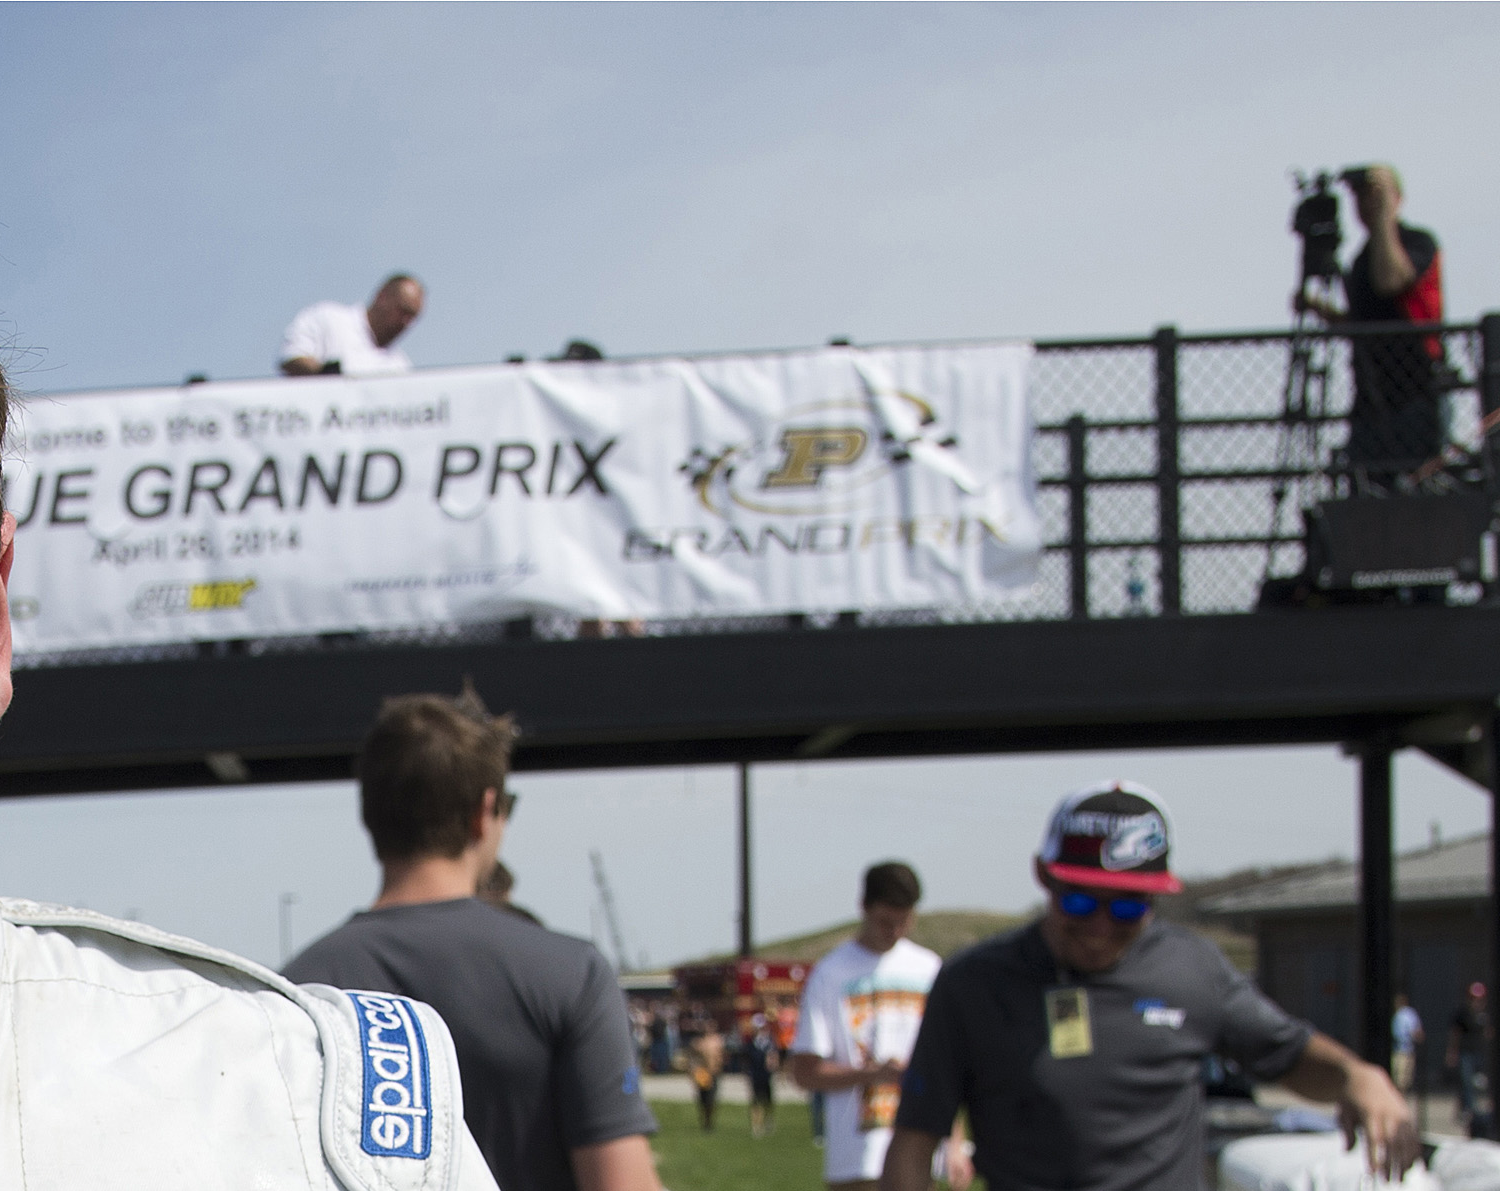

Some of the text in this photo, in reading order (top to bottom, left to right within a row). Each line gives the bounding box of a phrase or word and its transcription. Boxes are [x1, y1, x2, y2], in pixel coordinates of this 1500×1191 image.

[121, 418, 155, 448] to
[167, 412, 220, 445] the
[320, 397, 450, 432] Annual
[123, 449, 404, 521] GRAND
[435, 437, 618, 501] PRIX
[760, 424, 867, 489] P
[91, 533, 167, 570] April
[230, 526, 301, 557] 2014
[356, 995, 428, 1150] sparco
